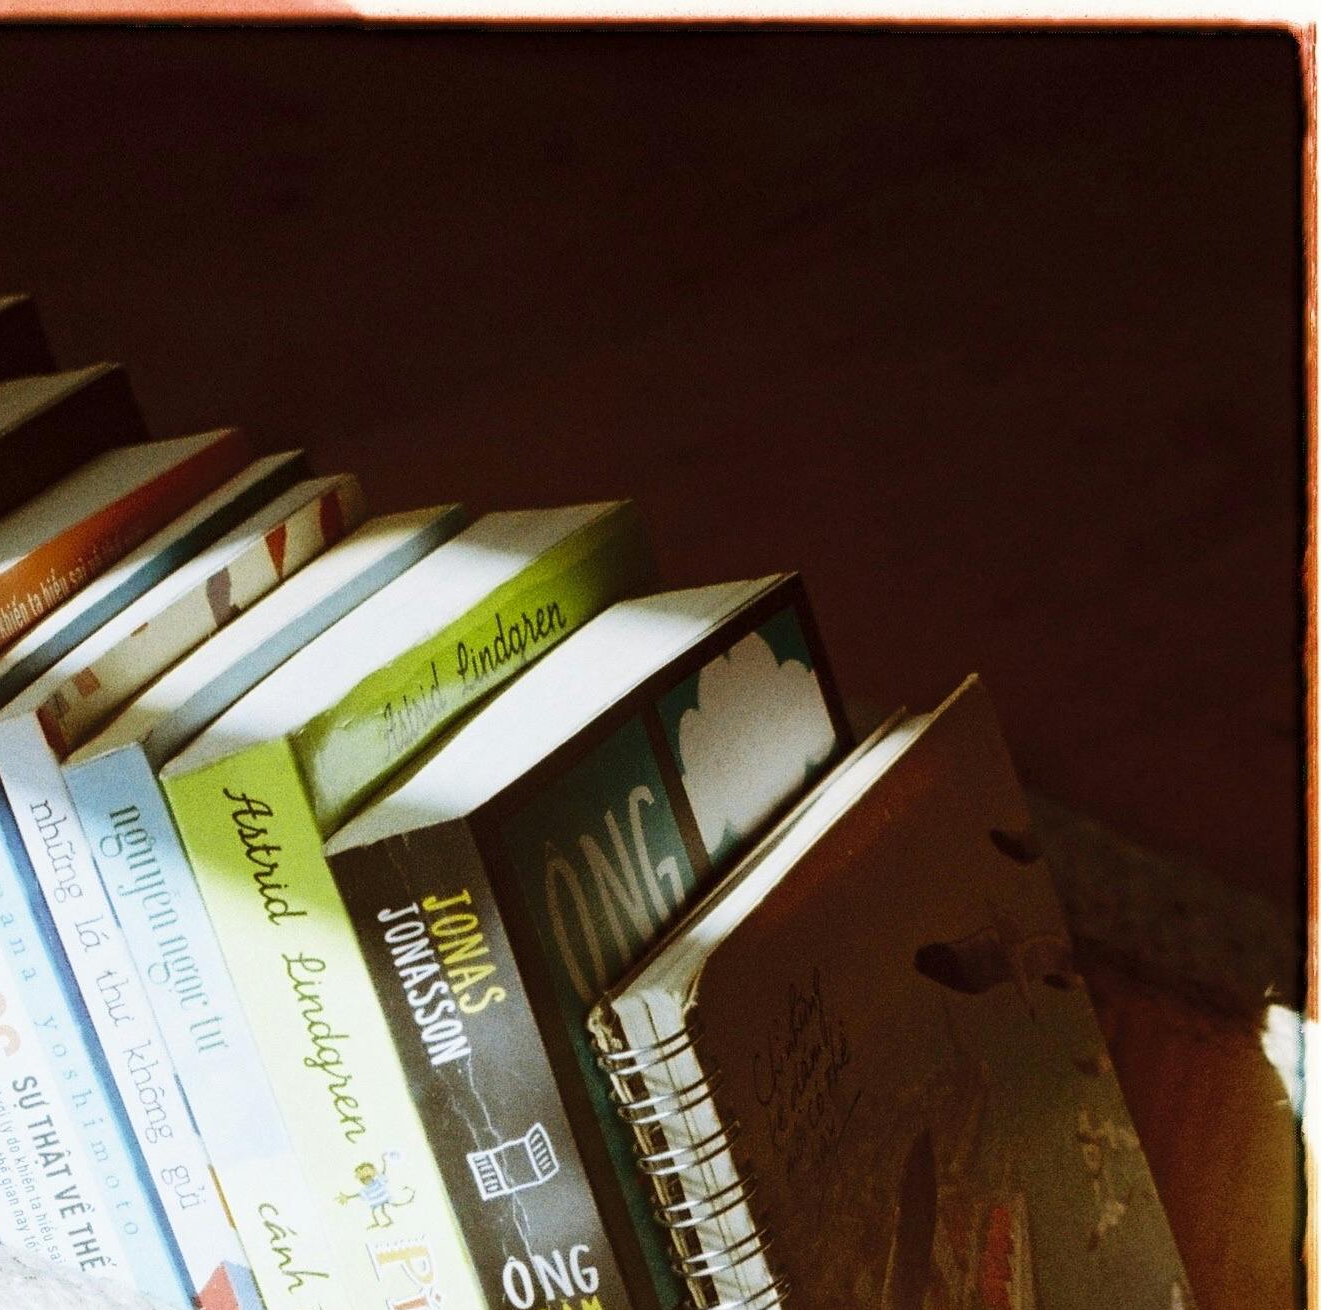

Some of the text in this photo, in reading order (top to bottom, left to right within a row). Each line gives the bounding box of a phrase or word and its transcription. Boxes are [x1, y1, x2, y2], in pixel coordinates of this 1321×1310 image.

[29, 799, 83, 903] những
[75, 913, 110, 953] lá
[123, 1039, 174, 1144] không
[222, 787, 367, 1144] Astrid Lindgren
[377, 902, 472, 1066] JONASSON
[422, 889, 506, 1014] JONAS
[6, 1135, 24, 1153] do
[12, 1075, 117, 1272] SỰ THẬT VỀ THẾ
[34, 1015, 139, 1236] yoshimoto
[258, 1203, 329, 1293] cánh
